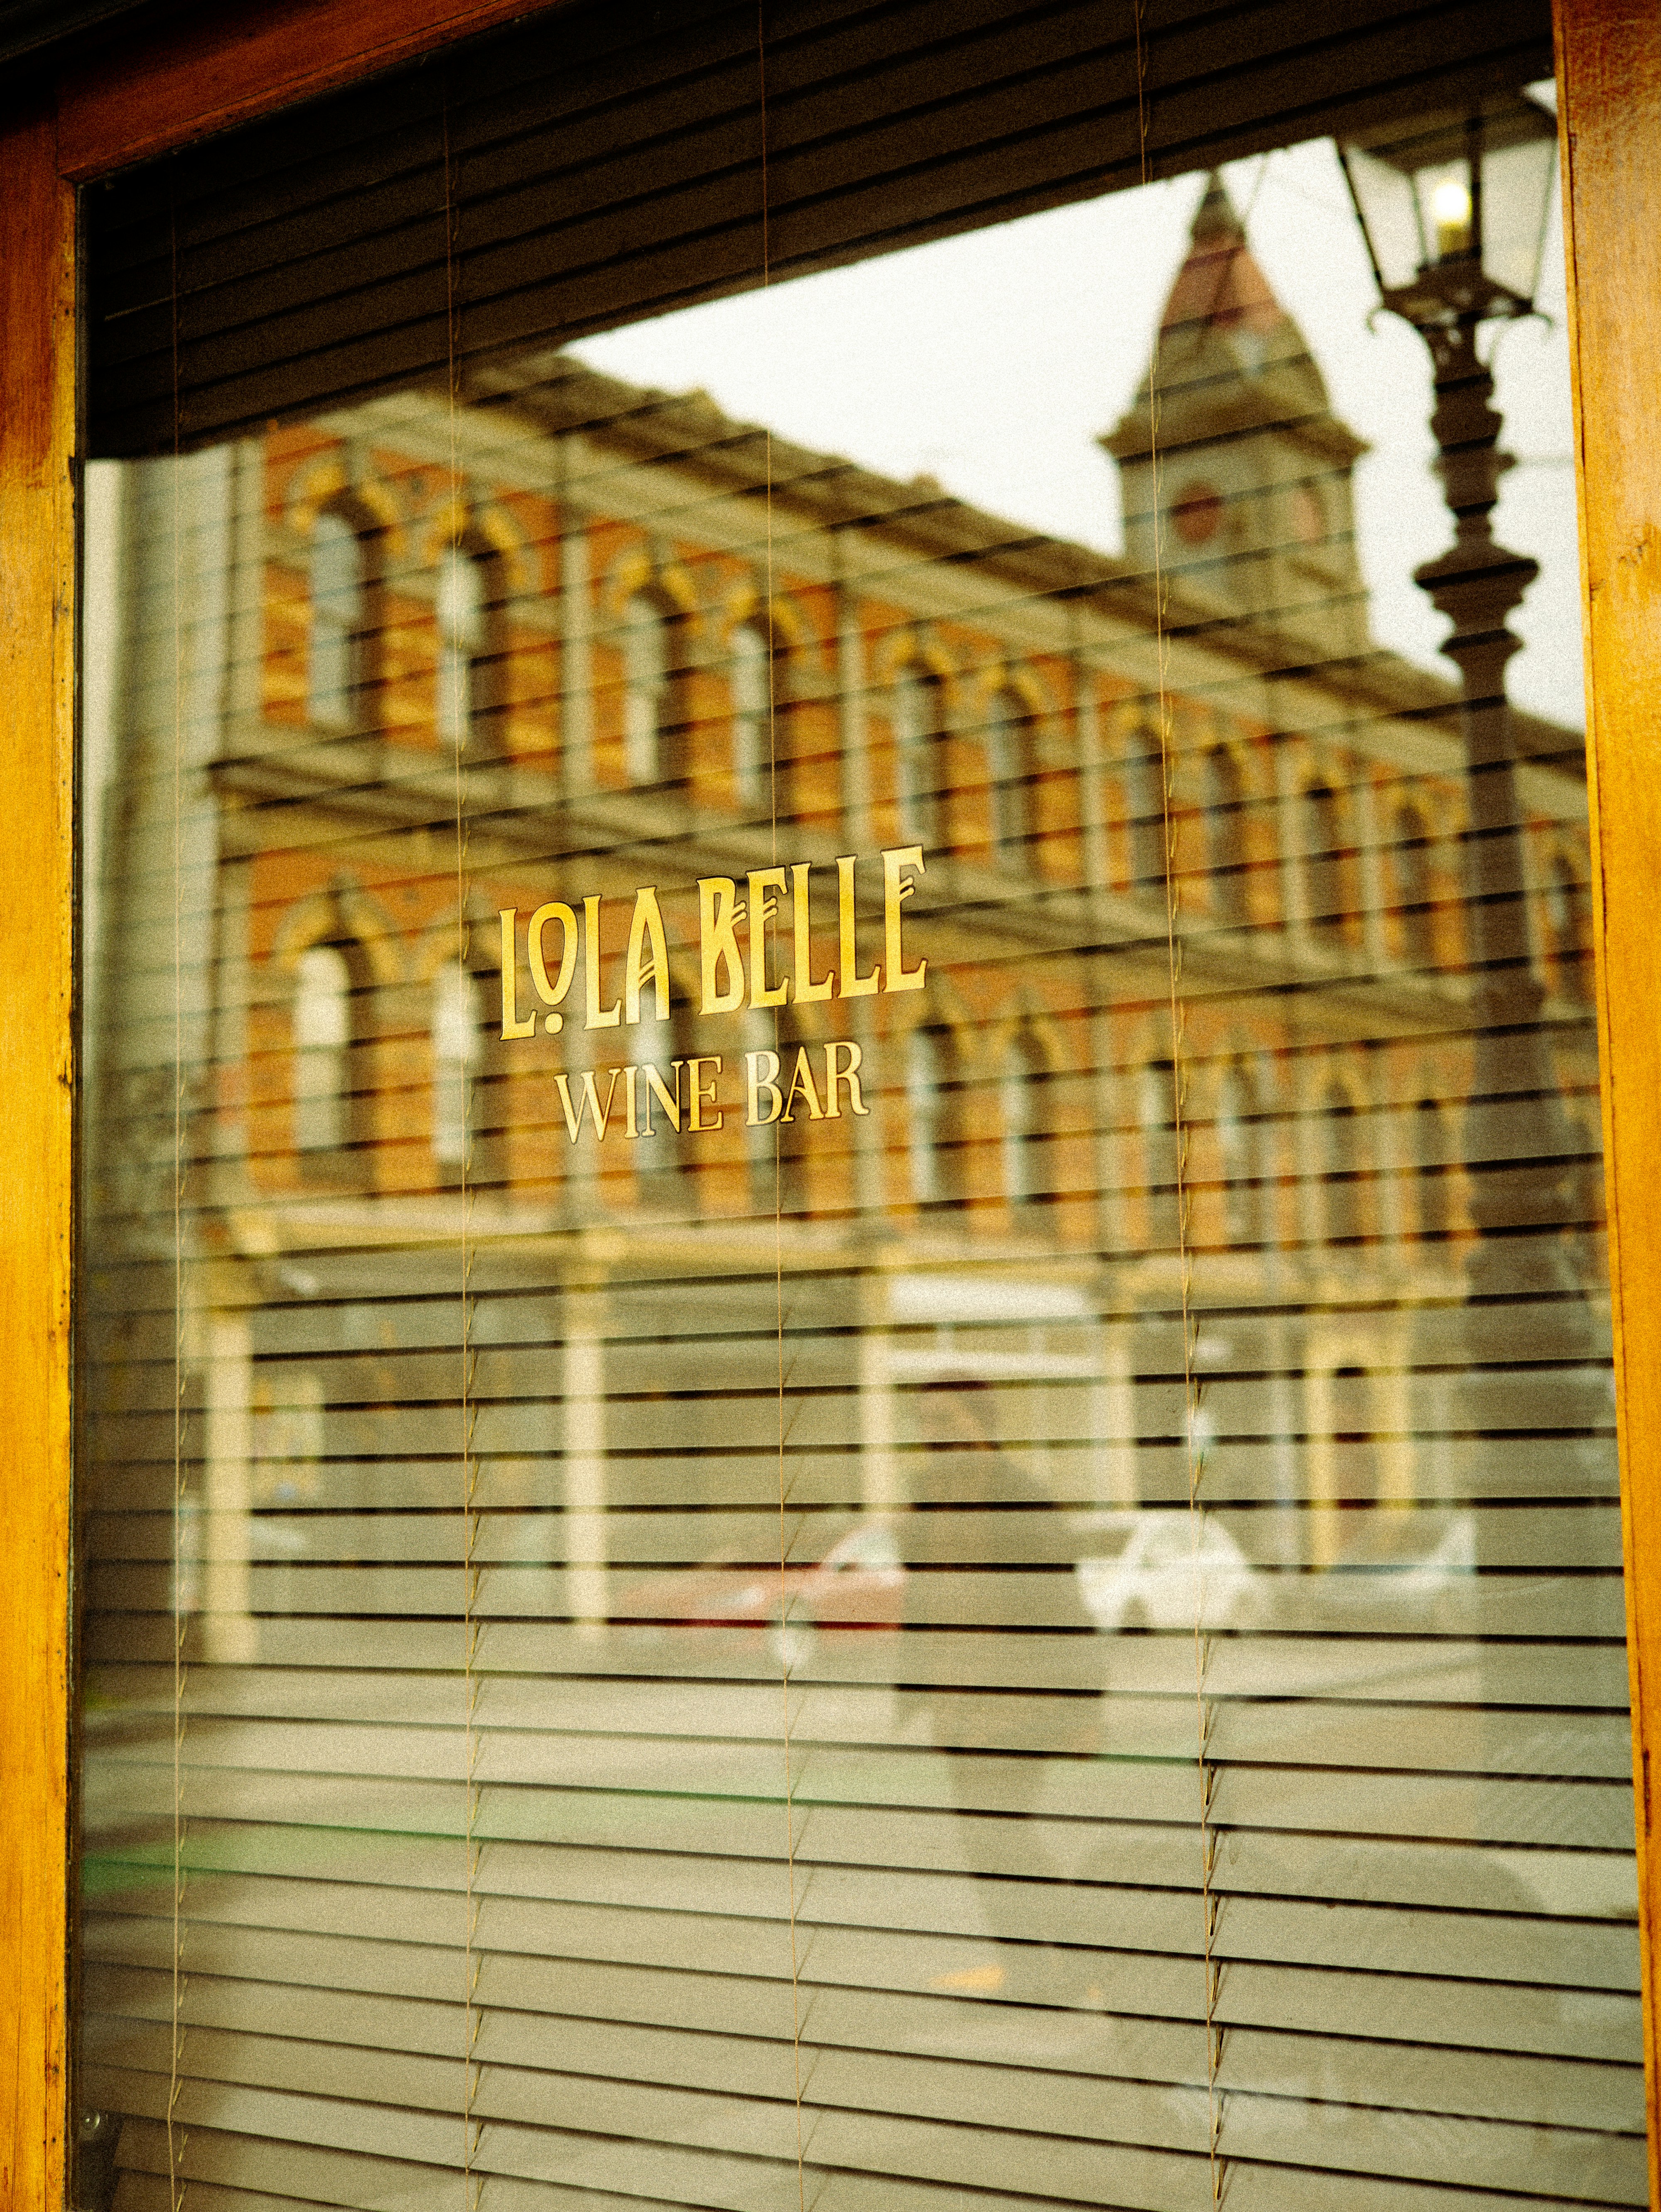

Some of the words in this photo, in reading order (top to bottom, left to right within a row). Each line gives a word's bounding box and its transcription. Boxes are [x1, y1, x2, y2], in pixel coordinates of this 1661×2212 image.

[499, 885, 670, 1041] LOLA
[696, 844, 928, 1016] BELLE
[554, 1056, 724, 1145] WINE
[745, 1041, 869, 1128] BAR
